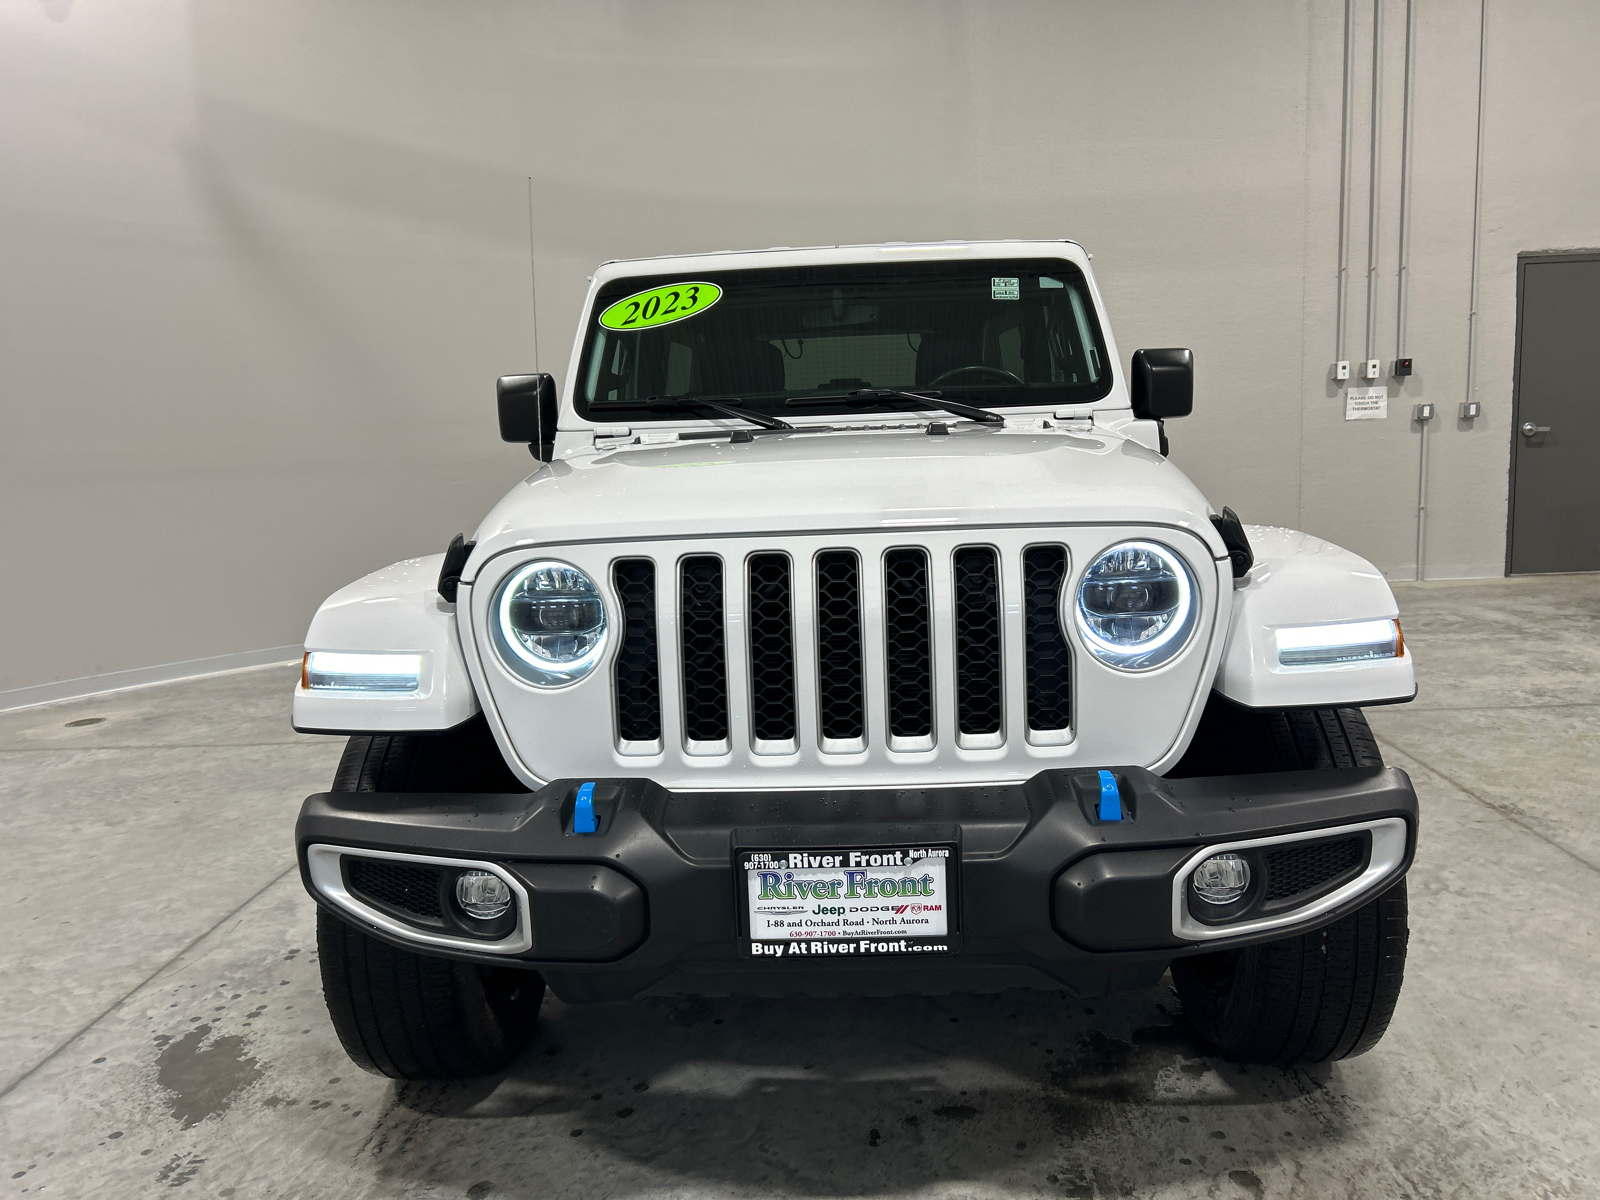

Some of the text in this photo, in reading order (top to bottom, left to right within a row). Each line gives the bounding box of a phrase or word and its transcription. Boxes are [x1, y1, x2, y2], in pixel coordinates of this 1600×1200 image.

[621, 286, 700, 326] 2023
[751, 854, 771, 862] (630)
[788, 851, 903, 868] River Front
[909, 849, 949, 859] North Aurora
[744, 861, 779, 870] 907-1700
[757, 869, 935, 900] River Front
[812, 904, 846, 916] Jeep
[767, 917, 929, 928] I-88 and Orchard Road North Aurora
[843, 929, 907, 937] BuyAtRiverFront.com
[752, 942, 784, 957] Buy
[788, 942, 808, 954] At
[811, 941, 857, 954] River
